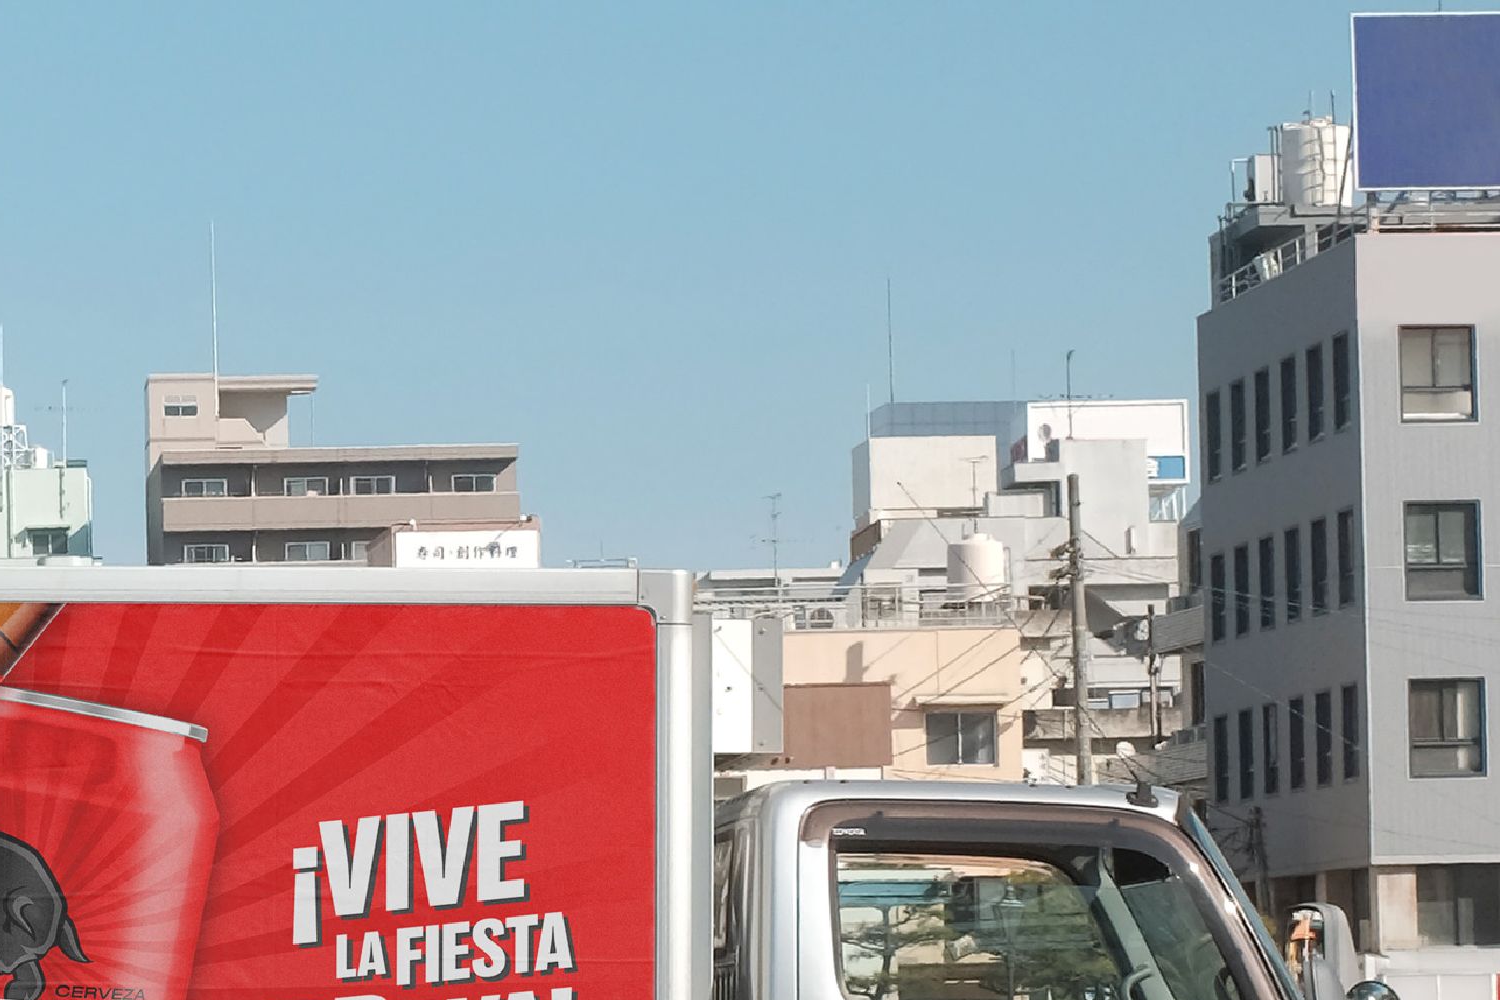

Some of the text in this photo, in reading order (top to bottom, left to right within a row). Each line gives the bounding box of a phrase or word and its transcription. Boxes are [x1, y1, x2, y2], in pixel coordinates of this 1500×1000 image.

[292, 800, 529, 947] ¡VIVE
[335, 911, 577, 989] LA FIESTA
